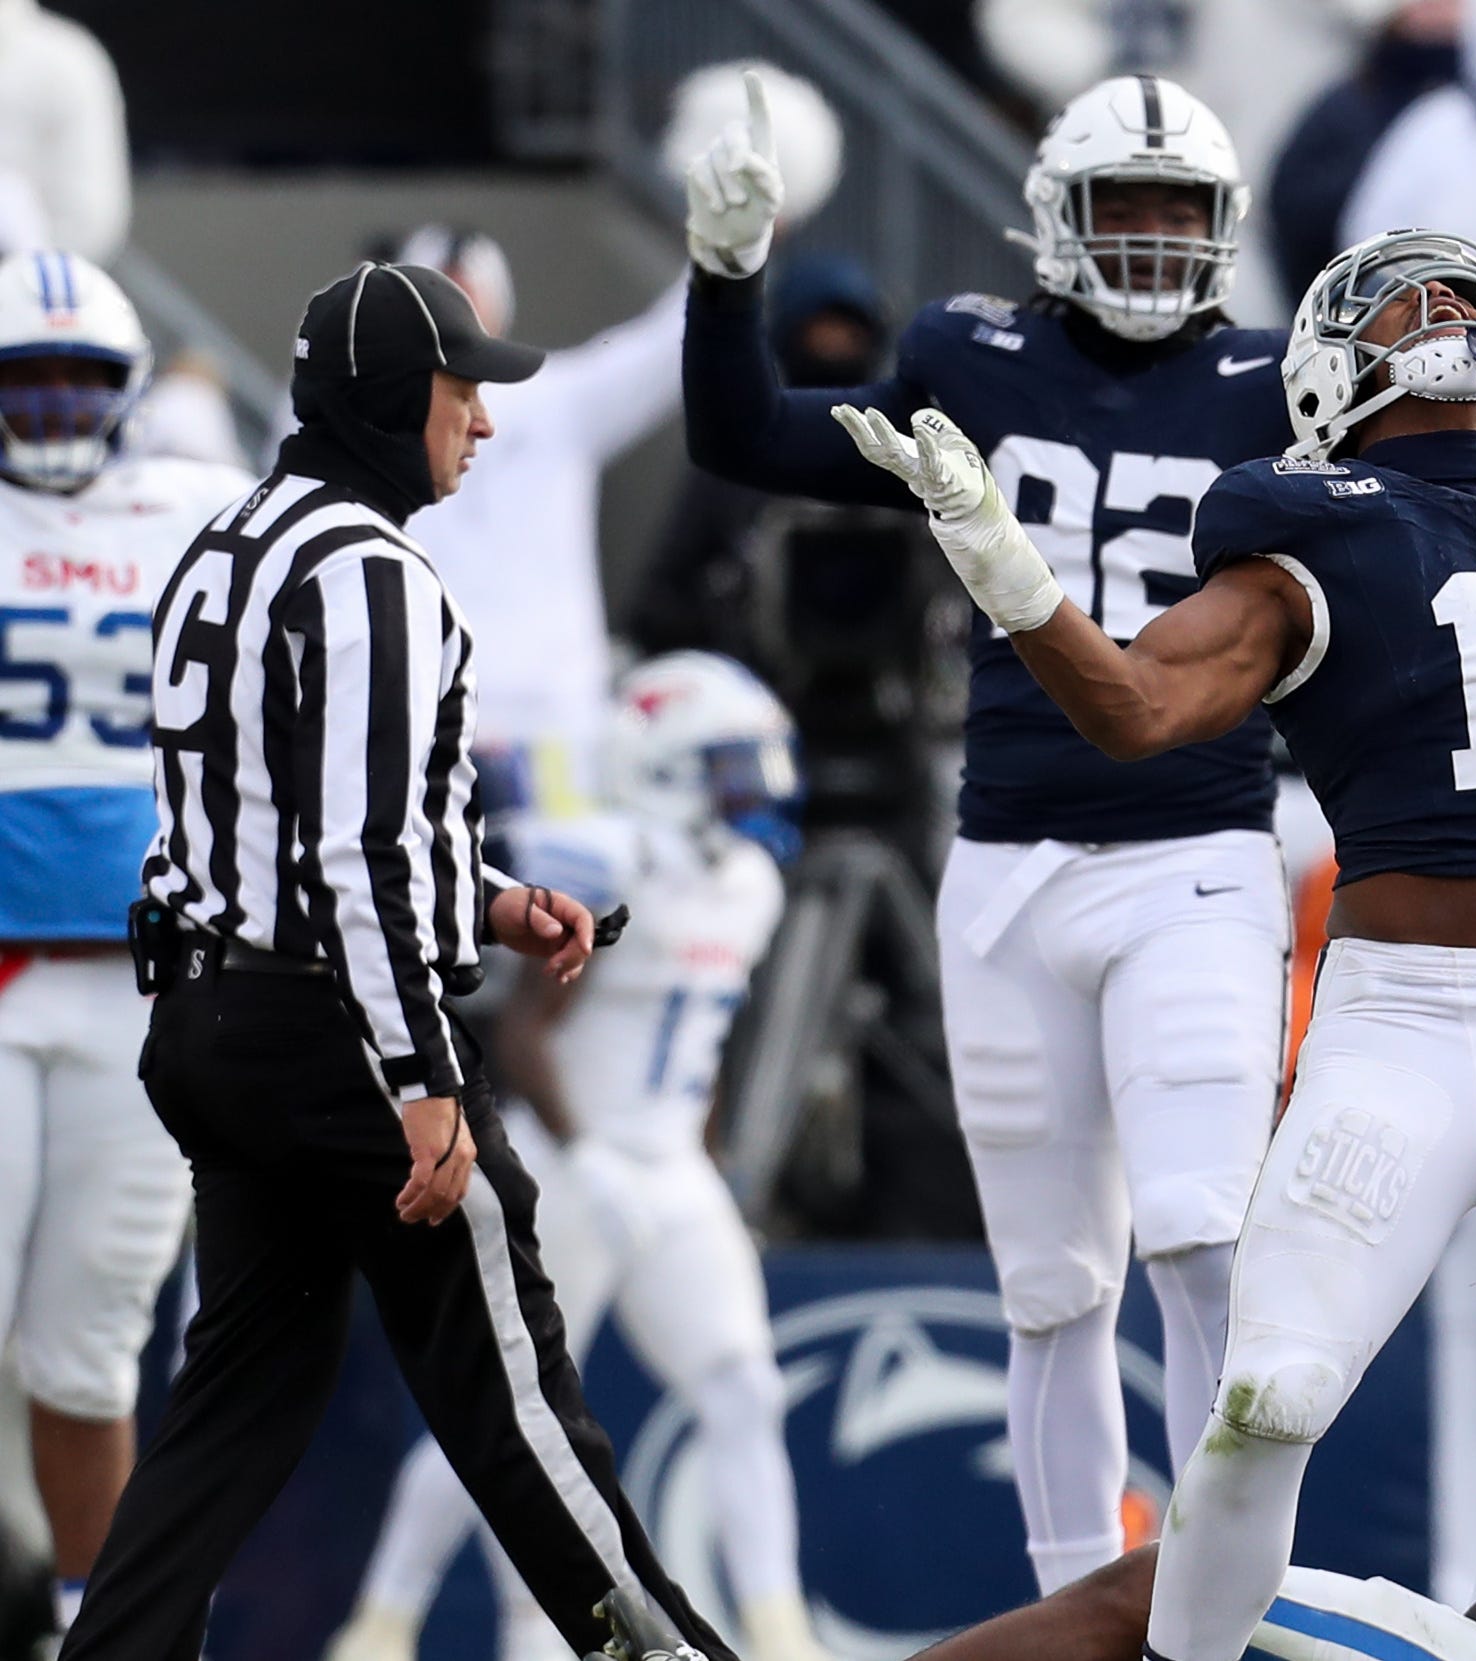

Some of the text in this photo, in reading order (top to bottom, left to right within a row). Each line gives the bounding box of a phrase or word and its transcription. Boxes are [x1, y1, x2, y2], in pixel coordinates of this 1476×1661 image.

[23, 553, 140, 594] SMU
[988, 434, 1223, 640] 92
[0, 606, 153, 746] 53
[152, 549, 234, 732] C
